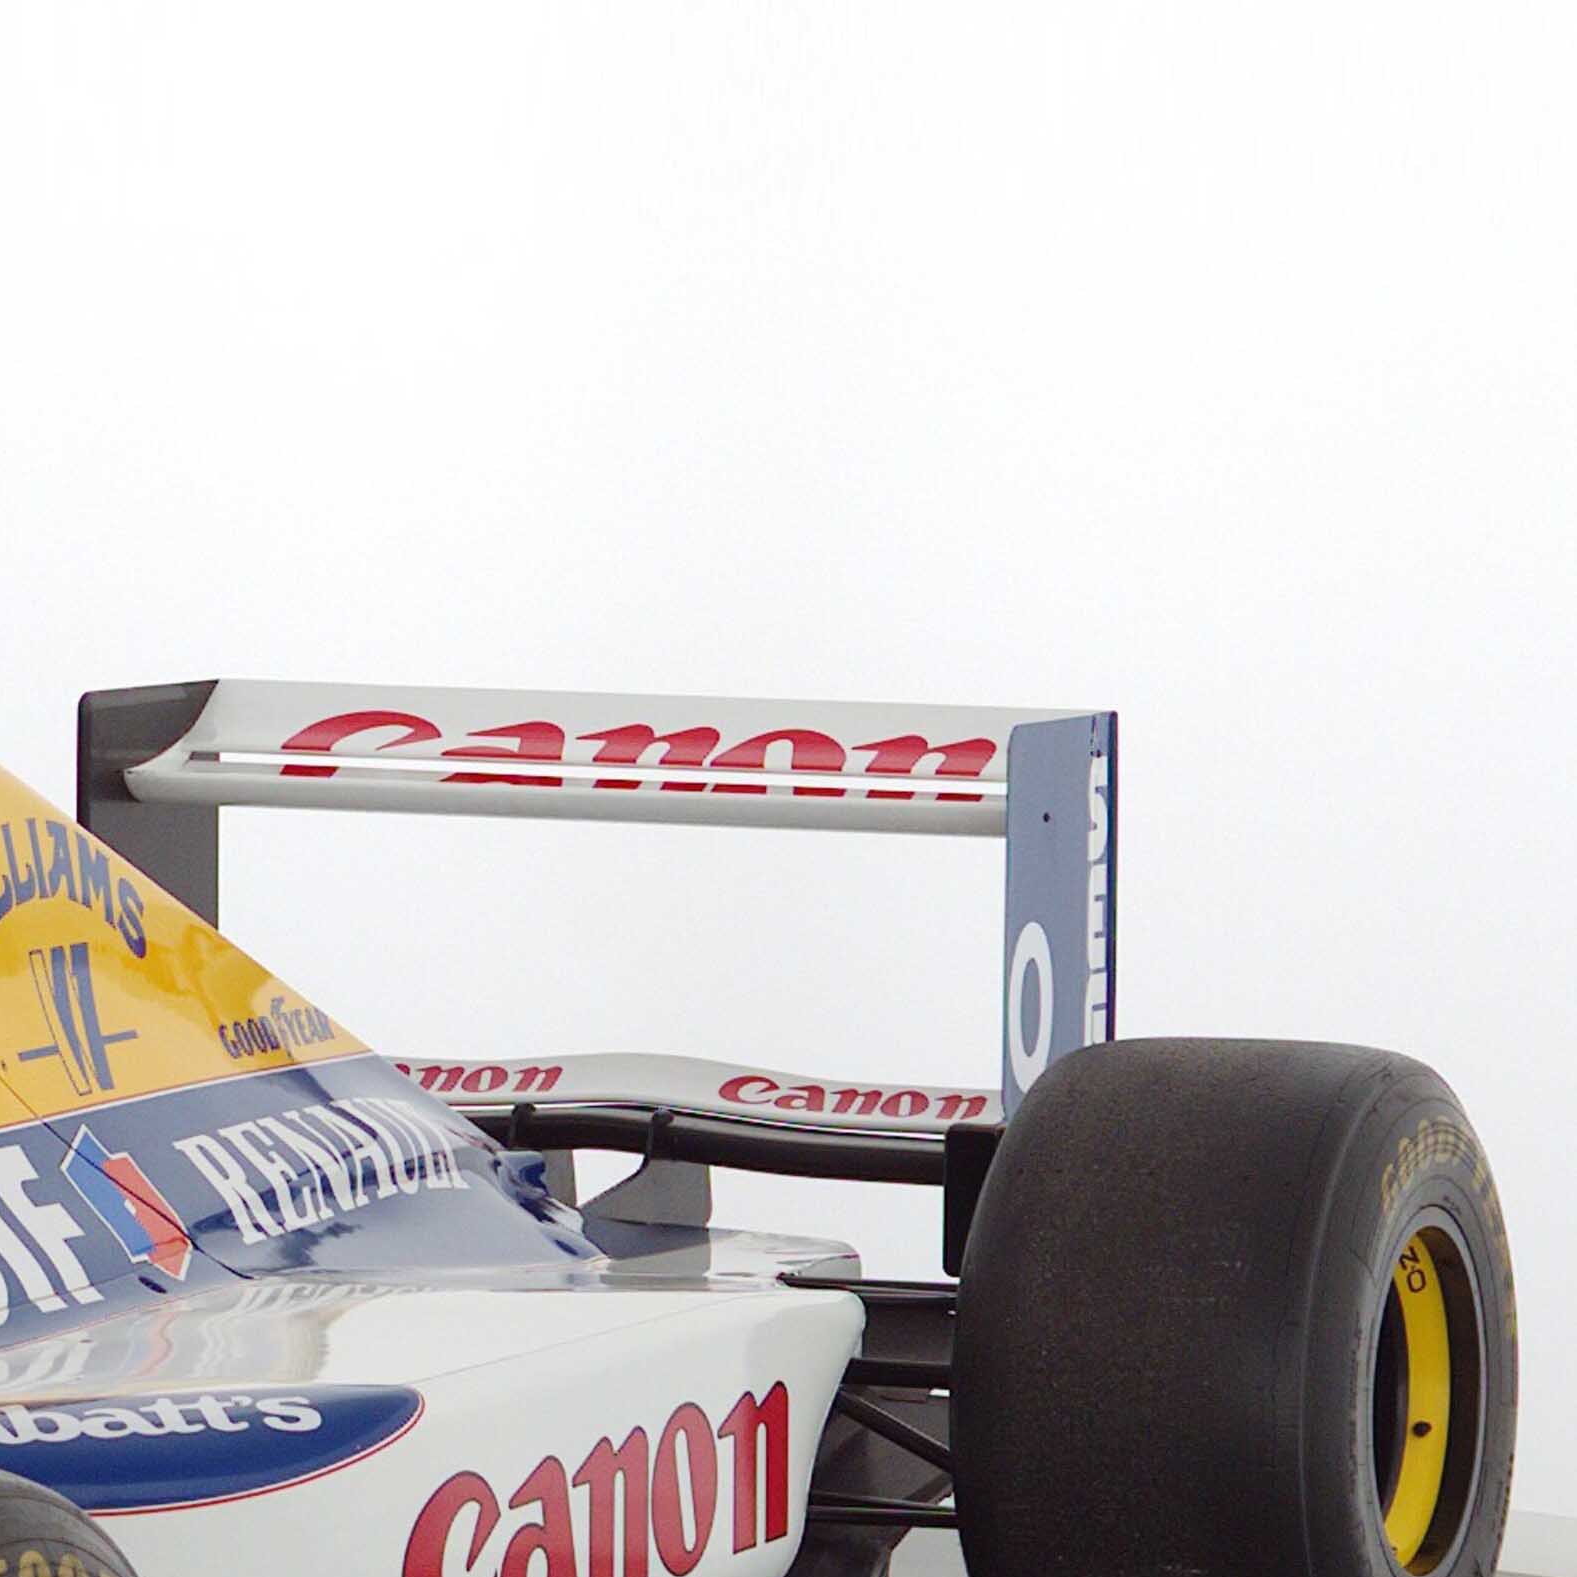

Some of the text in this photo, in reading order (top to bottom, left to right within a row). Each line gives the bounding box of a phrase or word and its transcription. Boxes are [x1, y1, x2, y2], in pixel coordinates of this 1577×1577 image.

[279, 710, 998, 803] Canon
[395, 1063, 563, 1093] non
[718, 1075, 988, 1120] Canon
[174, 1098, 470, 1245] RENAULT
